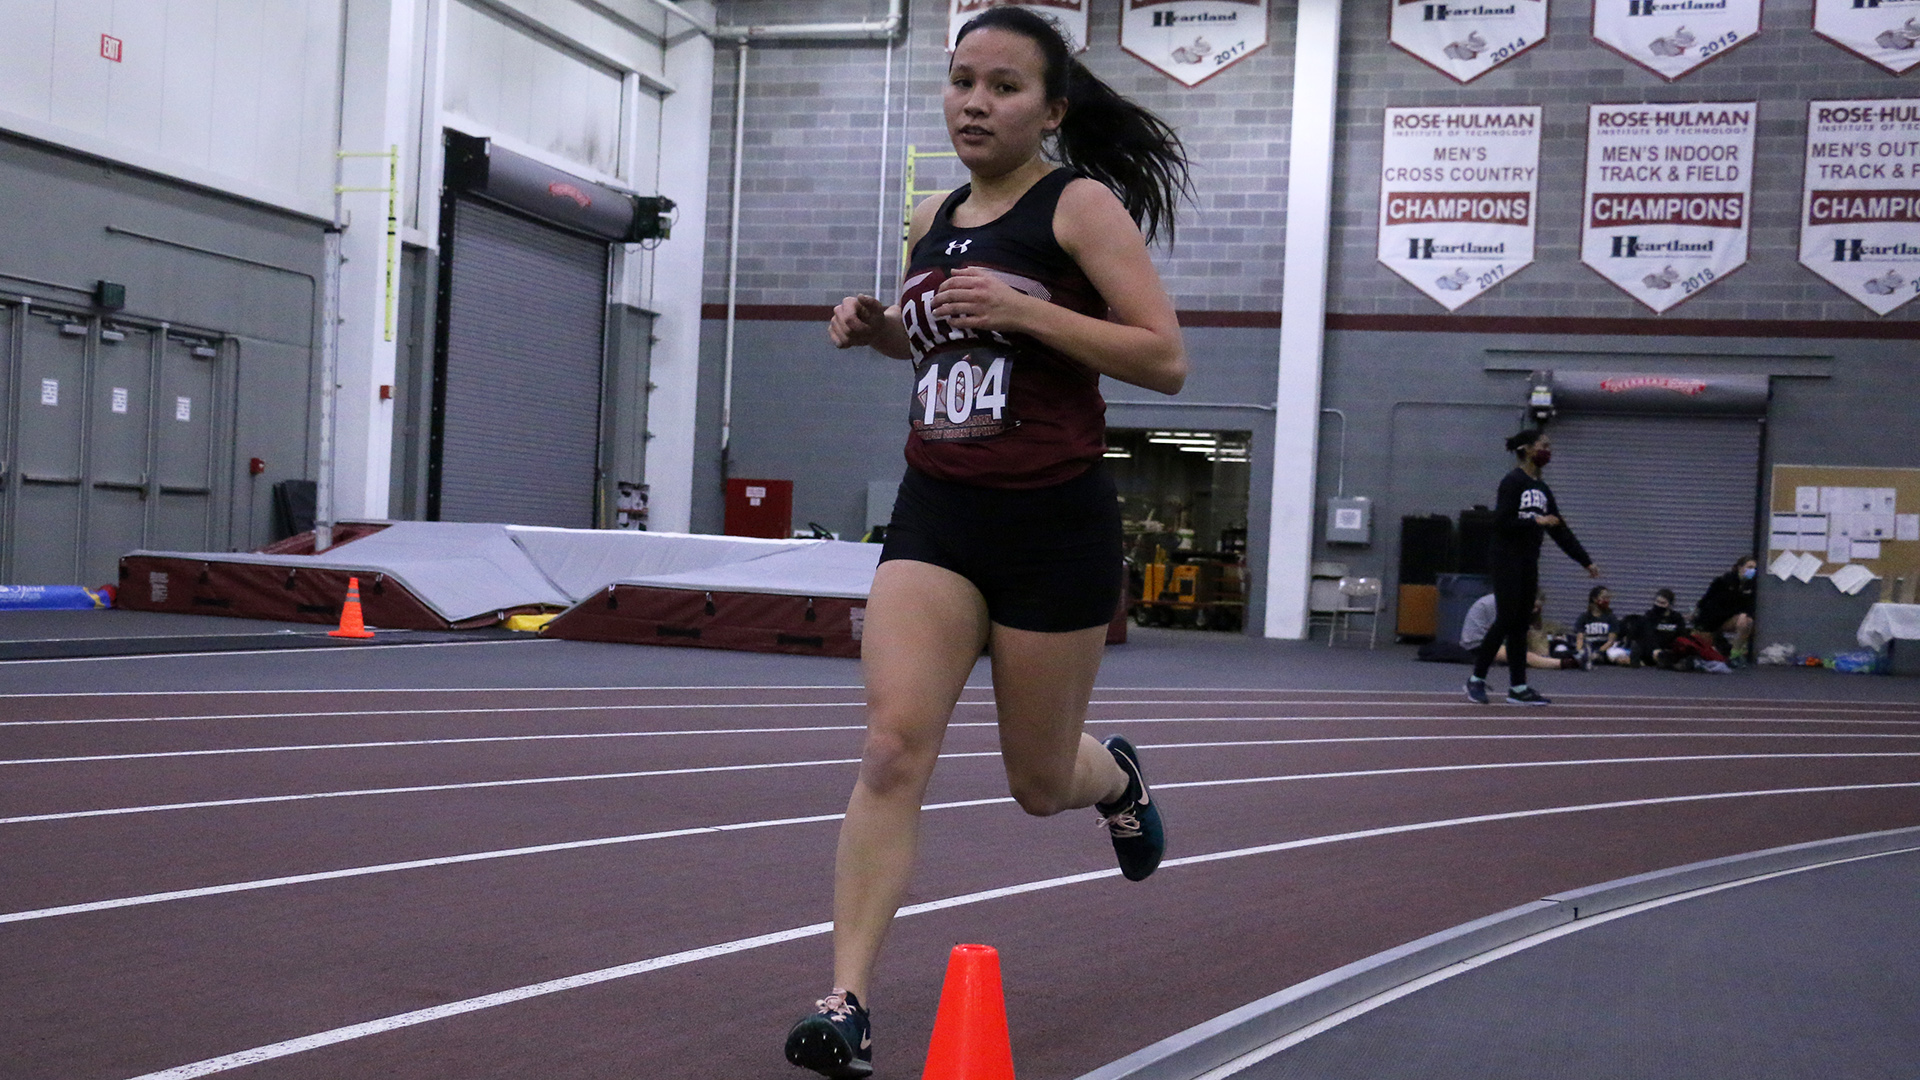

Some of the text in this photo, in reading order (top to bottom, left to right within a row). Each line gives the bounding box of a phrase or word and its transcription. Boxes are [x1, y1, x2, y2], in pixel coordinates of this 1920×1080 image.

[1153, 11, 1237, 27] Heartland
[1424, 4, 1515, 21] Heartland
[104, 37, 119, 60] EXIT
[1214, 40, 1245, 65] 2017
[1490, 37, 1526, 64] 2014
[1700, 31, 1738, 58] 2015
[1393, 113, 1535, 129] ROSE-HULMAN
[1598, 110, 1749, 127] ROSE-HULMAN
[1433, 146, 1487, 161] MEN'S
[1602, 145, 1738, 162] MEN'S INDOOR
[1811, 142, 1871, 158] MEN'S
[1385, 167, 1535, 182] CROSS COUNTRY
[1600, 165, 1739, 182] TRACK & FIELD
[1819, 164, 1886, 179] TRACK
[1892, 163, 1904, 178] &
[1389, 198, 1527, 220] CHAMPIONS
[1594, 198, 1741, 220] CHAMPIONS
[1408, 238, 1505, 260] Heartland
[1610, 235, 1714, 258] Heartland
[1476, 264, 1506, 290] 2017
[1681, 268, 1715, 294] 2018
[917, 357, 1006, 425] 104
